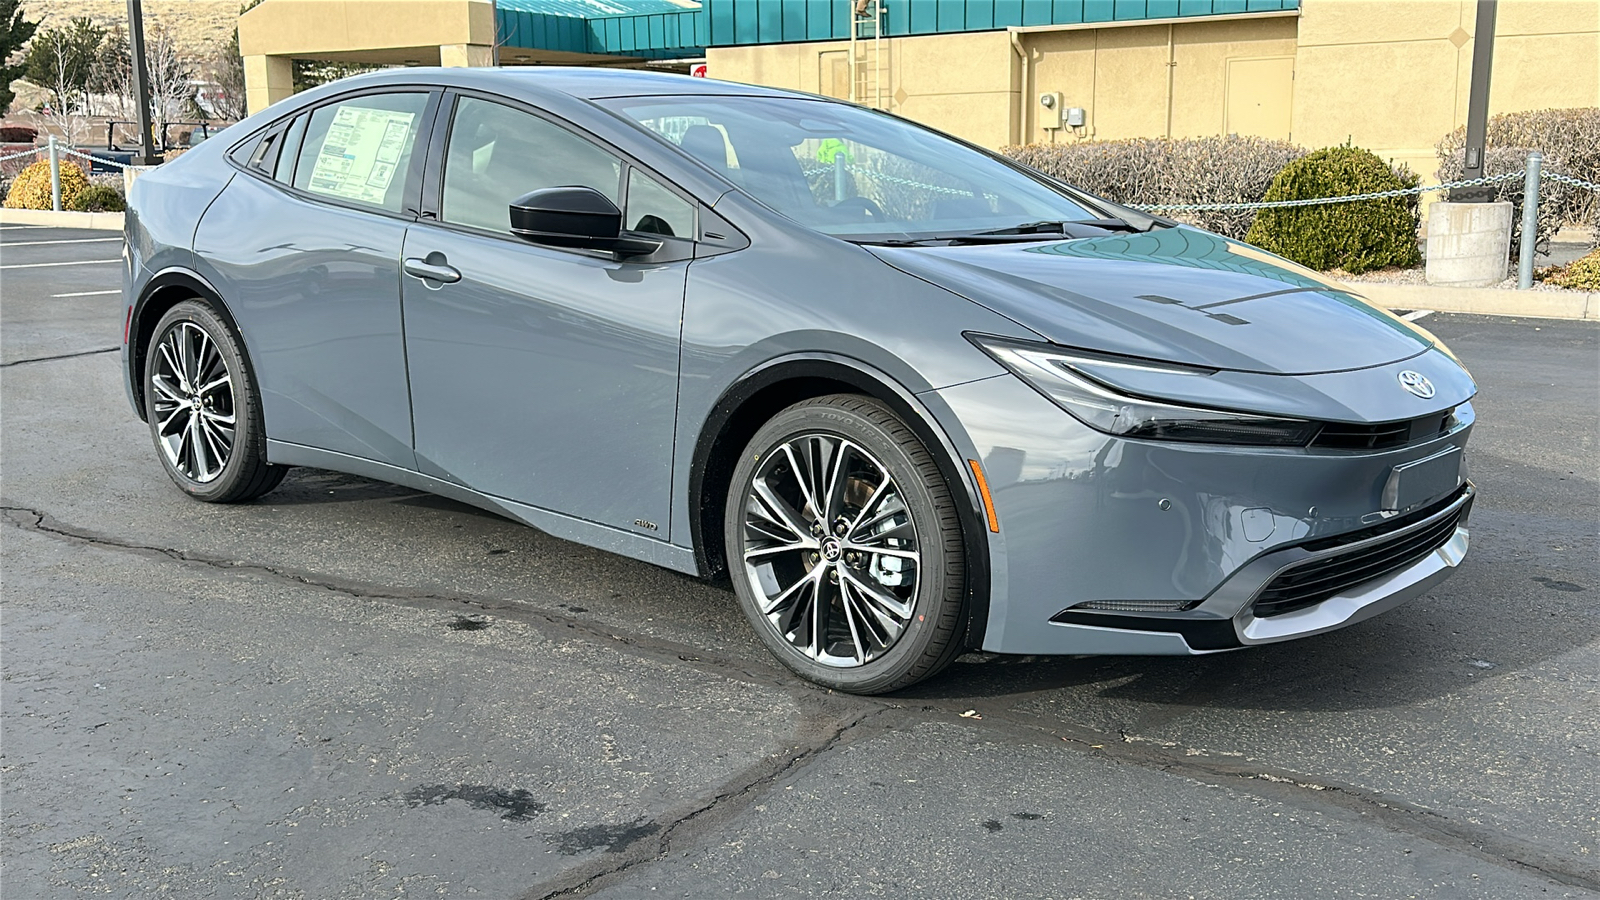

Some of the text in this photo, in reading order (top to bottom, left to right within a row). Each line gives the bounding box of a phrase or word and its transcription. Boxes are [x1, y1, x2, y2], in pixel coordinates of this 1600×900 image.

[821, 412, 891, 451] TOYO TIRES
[634, 518, 658, 531] AWD
